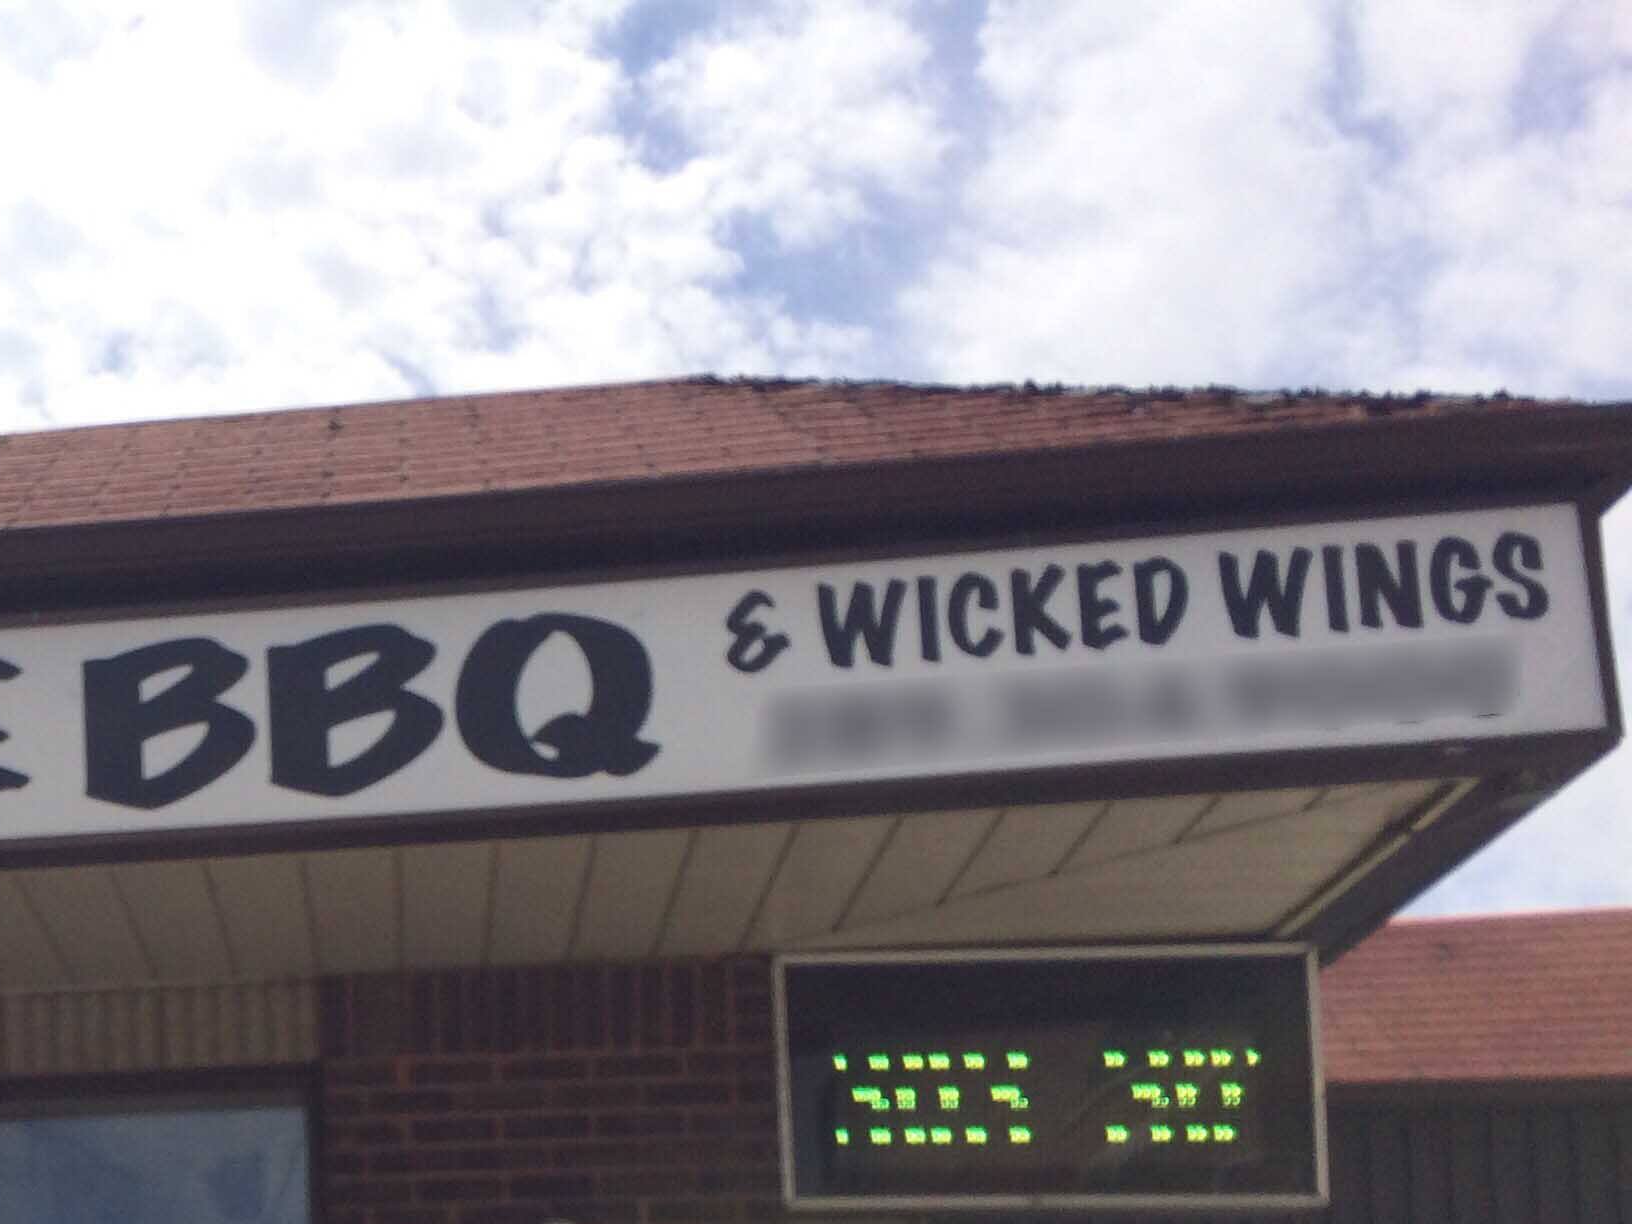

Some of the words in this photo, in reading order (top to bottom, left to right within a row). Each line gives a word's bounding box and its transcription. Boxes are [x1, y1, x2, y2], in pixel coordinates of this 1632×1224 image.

[726, 590, 790, 673] &
[816, 557, 1189, 671] WICKED
[1217, 531, 1550, 639] WINGS
[83, 612, 661, 809] BBQ
